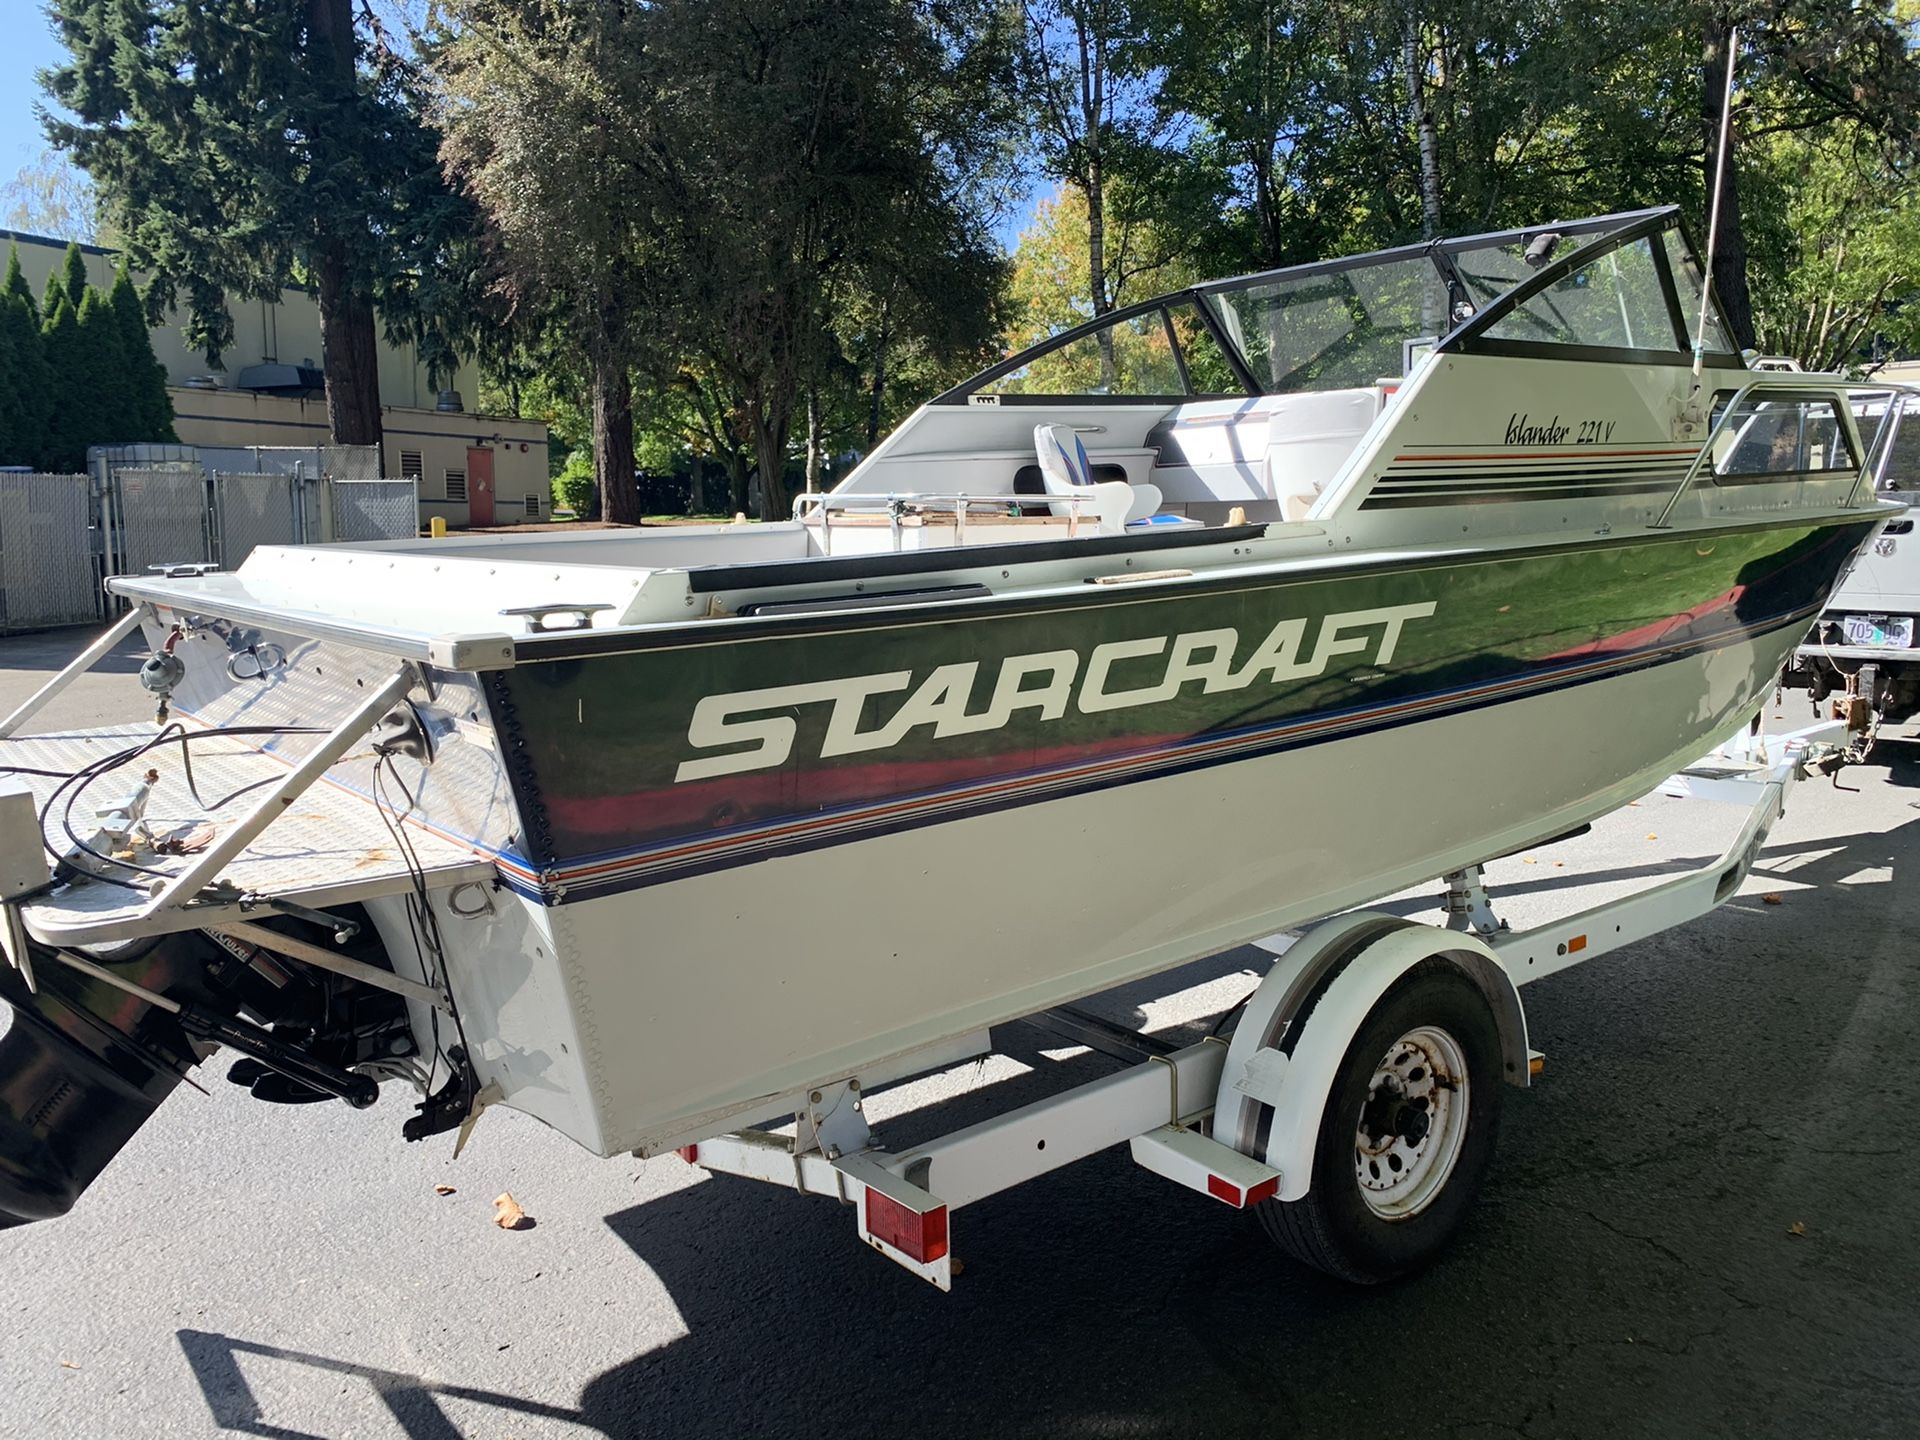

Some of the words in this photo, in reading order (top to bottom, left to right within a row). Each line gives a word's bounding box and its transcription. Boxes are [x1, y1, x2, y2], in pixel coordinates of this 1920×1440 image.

[1504, 413, 1570, 445] Islander
[1576, 421, 1603, 443] 221
[1848, 622, 1874, 639] 705
[674, 601, 1438, 784] STARCRAFT
